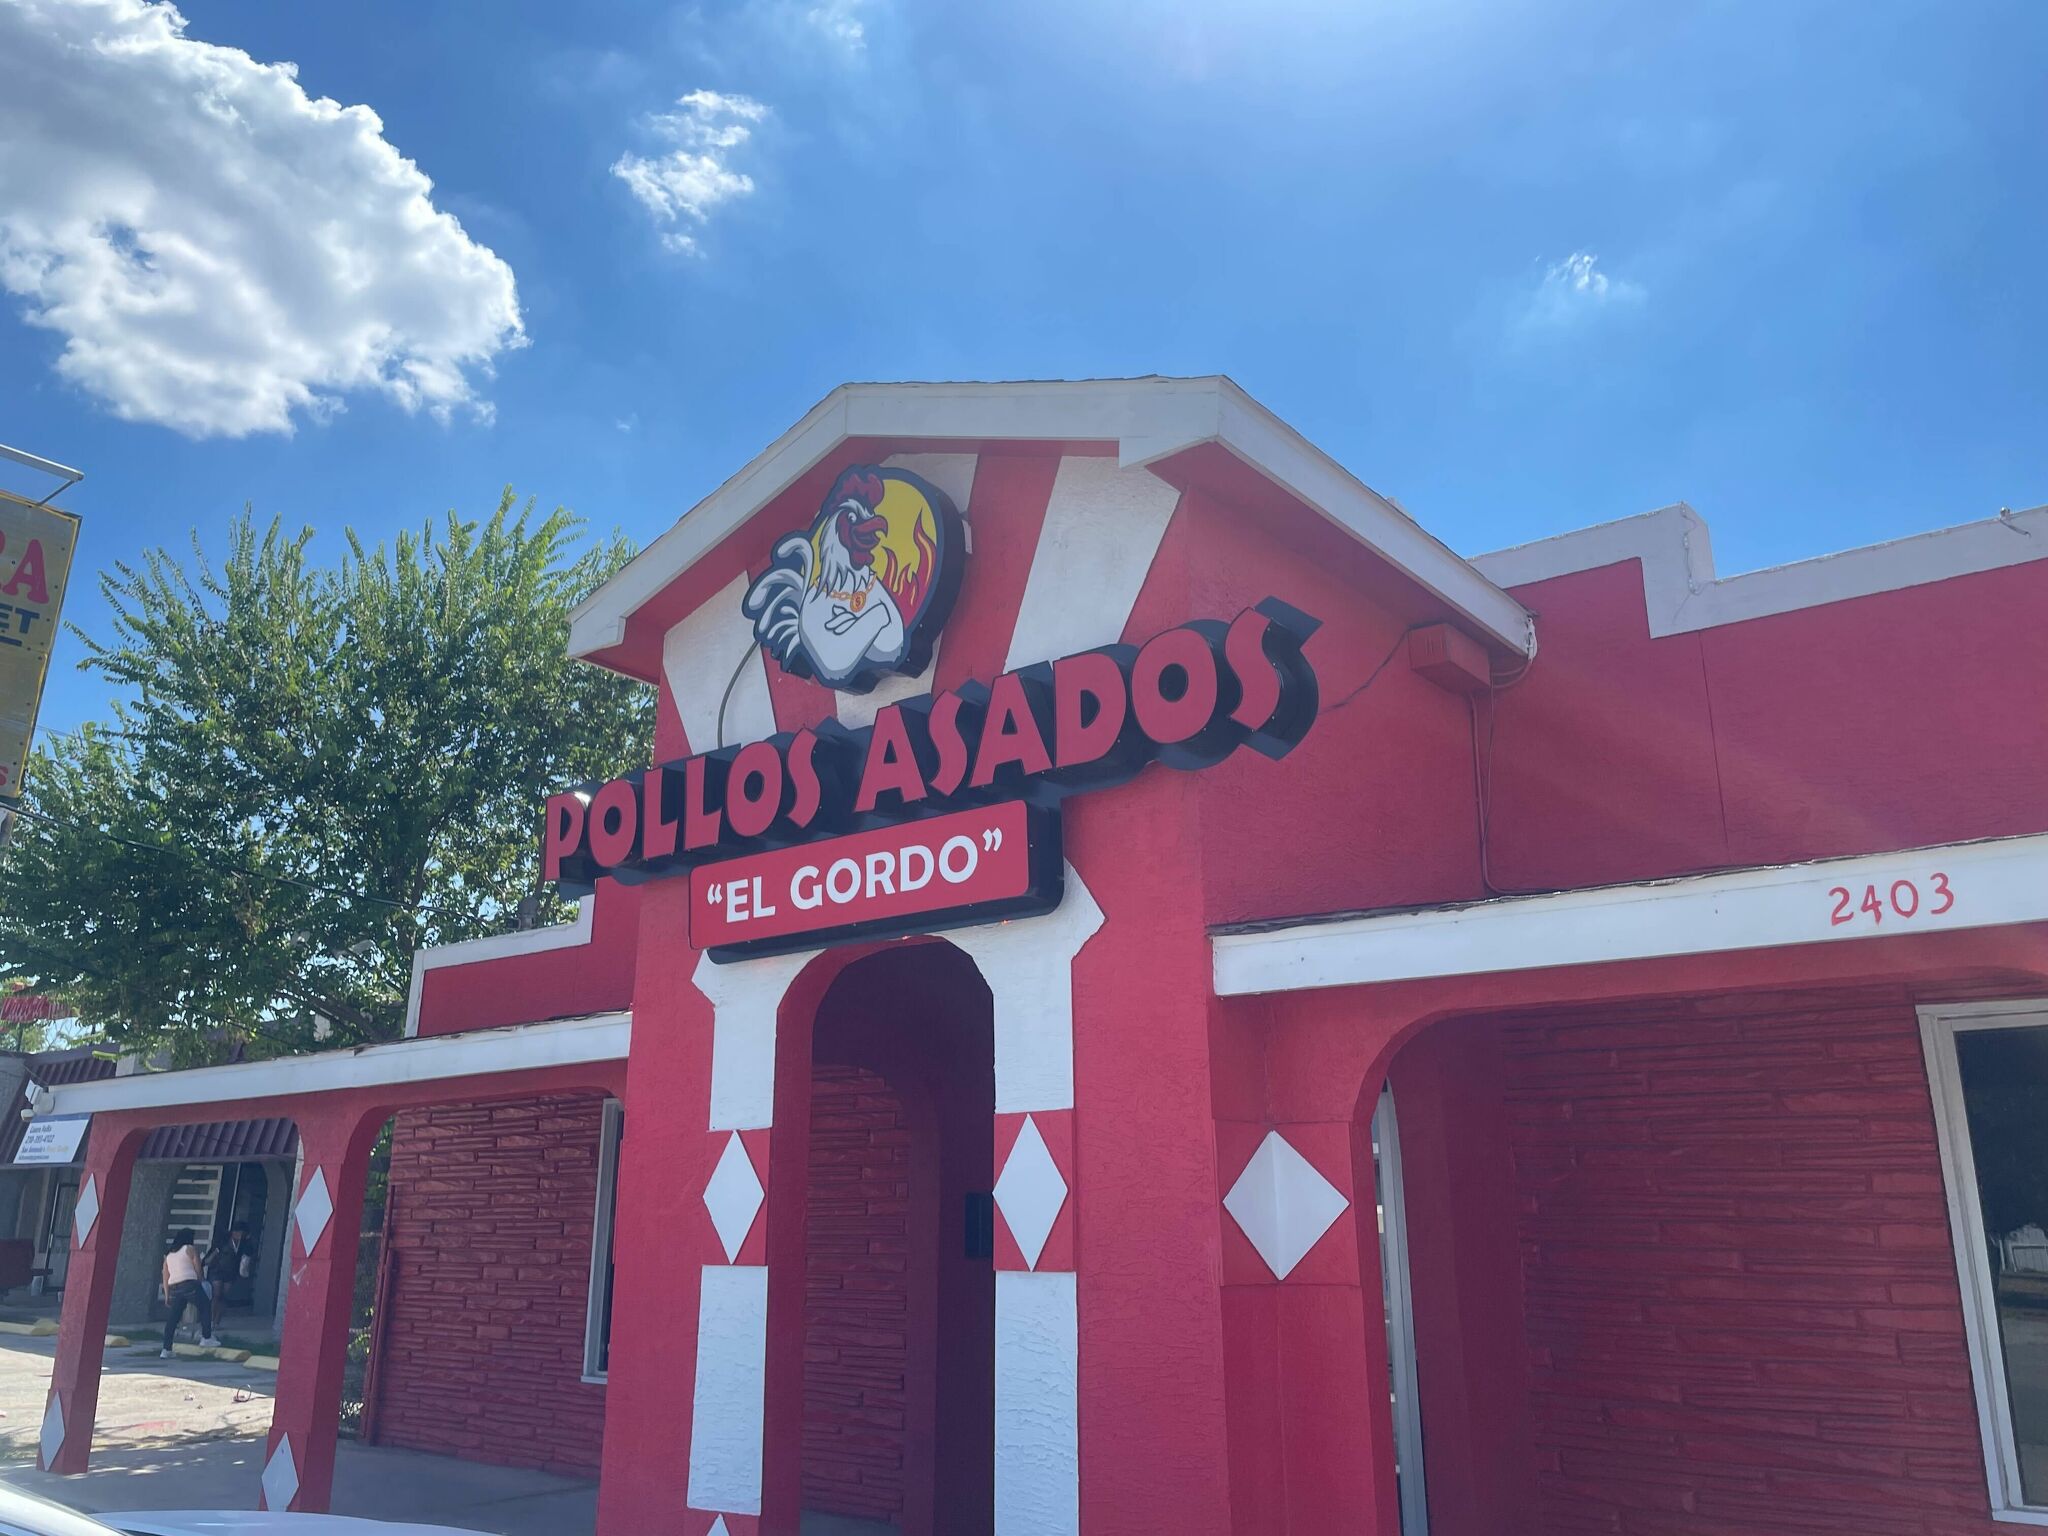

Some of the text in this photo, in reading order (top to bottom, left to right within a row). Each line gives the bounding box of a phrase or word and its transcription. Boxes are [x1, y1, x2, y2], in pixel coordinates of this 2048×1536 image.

[0, 530, 49, 604] A
[545, 606, 1281, 880] POLLOS ASADOS
[1828, 872, 1954, 926] 2403
